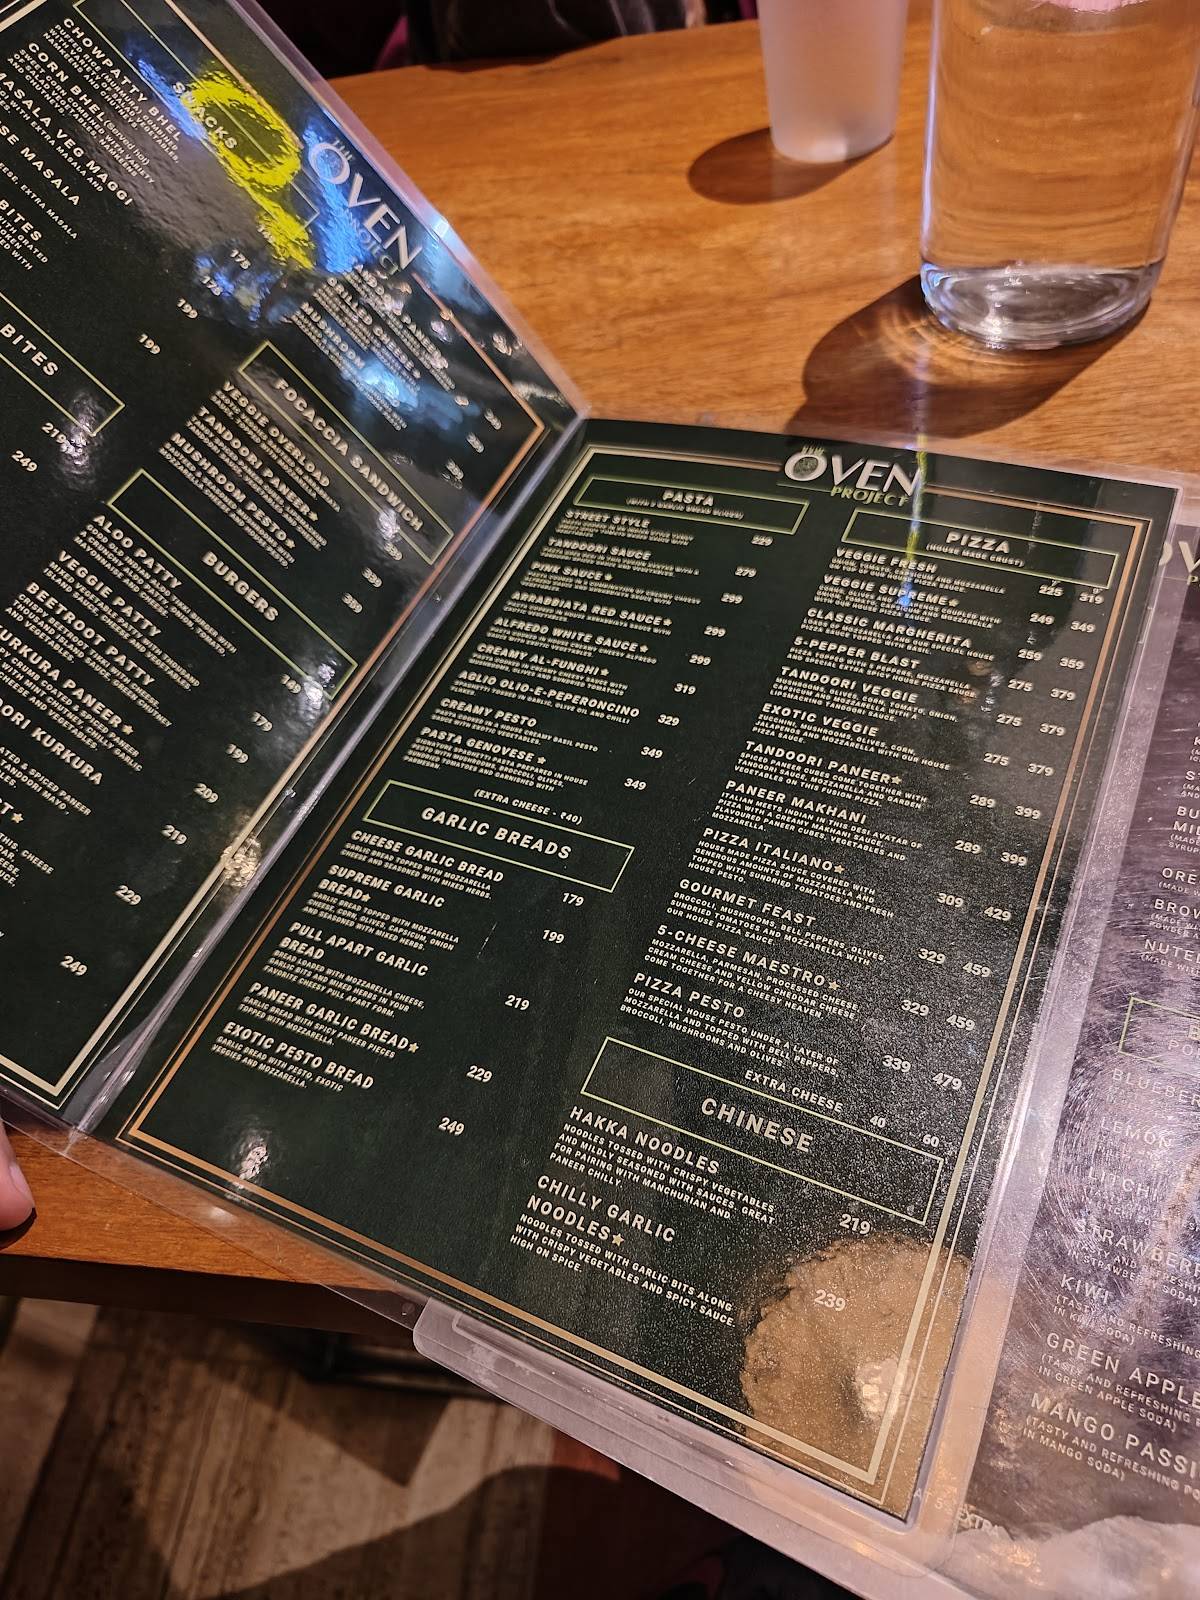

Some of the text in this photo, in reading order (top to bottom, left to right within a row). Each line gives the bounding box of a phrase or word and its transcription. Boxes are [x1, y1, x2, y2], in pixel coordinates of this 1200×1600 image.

[26, 40, 70, 84] CORN
[69, 84, 108, 122] BHEL
[61, 16, 184, 142] CHOWPATTY BHEL
[81, 72, 101, 91] AND
[19, 146, 83, 207] MASALA
[53, 127, 87, 159] VEG
[85, 158, 134, 207] MAGGI
[0, 198, 43, 243] BITES
[307, 141, 424, 271] OVEN
[174, 297, 199, 321] 199
[0, 321, 60, 378] BITES
[40, 421, 68, 446] 219
[221, 380, 331, 489] VEGGIE OVERLOAD
[273, 377, 352, 457] FOCACCIA
[348, 453, 424, 532] SANDWICH
[10, 448, 39, 474] 249
[196, 405, 311, 517] TANDOORI PANEER
[784, 451, 921, 497] OVEN
[171, 431, 288, 543] MUSHROOM PESTO
[660, 489, 717, 506] PASTA
[829, 484, 910, 508] PROJECT
[92, 511, 183, 592] ALOO PATTY
[944, 530, 1014, 554] PIZZA
[55, 548, 162, 641] VEGGIE PATTY
[200, 548, 280, 625] BURGERS
[25, 579, 155, 689] BEETROOT PATTY
[492, 616, 639, 652] ALFREDO WHITE SAUCE
[805, 608, 974, 648] CLASSIC MARGHERITA
[474, 642, 601, 676] CREAMY AL-FUNGHI
[792, 636, 921, 669] 5-PEPPER BLAST
[61, 676, 123, 730] PANEER
[456, 669, 642, 718] AGLIO OLIO-E-PEPERONCINO
[778, 665, 920, 704] TANDOORI VEGGIE
[437, 696, 539, 728] CREAMY PESTO
[655, 713, 681, 727] 329
[761, 702, 879, 737] EXOTIC VEGGIE
[30, 725, 105, 787] KURKURA
[418, 726, 536, 762] PASTA GENOVESE
[638, 745, 665, 759] 349
[743, 740, 892, 784] TANDOORI PANEER
[471, 788, 511, 805] (EXTRA
[509, 798, 551, 816] CHEESE
[621, 776, 648, 791] 349
[724, 780, 868, 825] PANEER MAKHANI
[160, 821, 188, 848] 219
[418, 806, 574, 860] GARLIC BREADS
[702, 827, 835, 872] PIZZA ITALIANO
[348, 828, 506, 884] CHEESE GARLIC BREAD
[114, 881, 143, 908] 229
[316, 877, 365, 901] BREAD
[326, 863, 446, 909] SUPREME GARLIC
[677, 878, 817, 927] GOURMET FEAST
[935, 891, 1012, 922] 309 429
[278, 936, 326, 961] BREAD
[287, 920, 430, 978] PULL APART GARLIC
[538, 928, 566, 946] 199
[655, 924, 828, 987] 5-CHEESE MAESTRO
[58, 952, 89, 980] 249
[916, 947, 992, 979] 329 459
[247, 981, 411, 1052] PANEER GARLIC BREAD
[502, 993, 531, 1013] 219
[632, 972, 747, 1019] PIZZA PESTO
[899, 998, 976, 1033] 329 459
[221, 1020, 376, 1091] EXOTIC PESTO BREAD
[464, 1063, 494, 1084] 229
[880, 1053, 963, 1092] 339 479
[437, 1116, 466, 1137] 249
[698, 1096, 815, 1153] CHINESE
[743, 1070, 941, 1149] EXTRA CHEESE 40 60
[568, 1106, 721, 1176] HAKKA NOODLES
[548, 1152, 624, 1189] PANEER CHILLY.
[557, 1132, 775, 1226] AND MILDLY SEASONED WITH SAUCES. GREAT
[562, 1123, 775, 1214] NOODLES TOSSED WITH CRISPY VEGETABLES
[525, 1194, 612, 1242] NOODLES
[535, 1174, 677, 1244] CHILLY GARLIC
[838, 1212, 872, 1237] 219
[509, 1234, 584, 1274] HIGH ON SPICE.
[812, 1287, 848, 1314] 239
[1060, 1272, 1108, 1306] KIWI
[1046, 1329, 1200, 1412] GREEN APPLE
[1053, 1368, 1094, 1396] GREEN
[1097, 1388, 1135, 1415] APPLE
[1030, 1389, 1196, 1483] MANGO PASSI
[1039, 1432, 1083, 1464] MANGO
